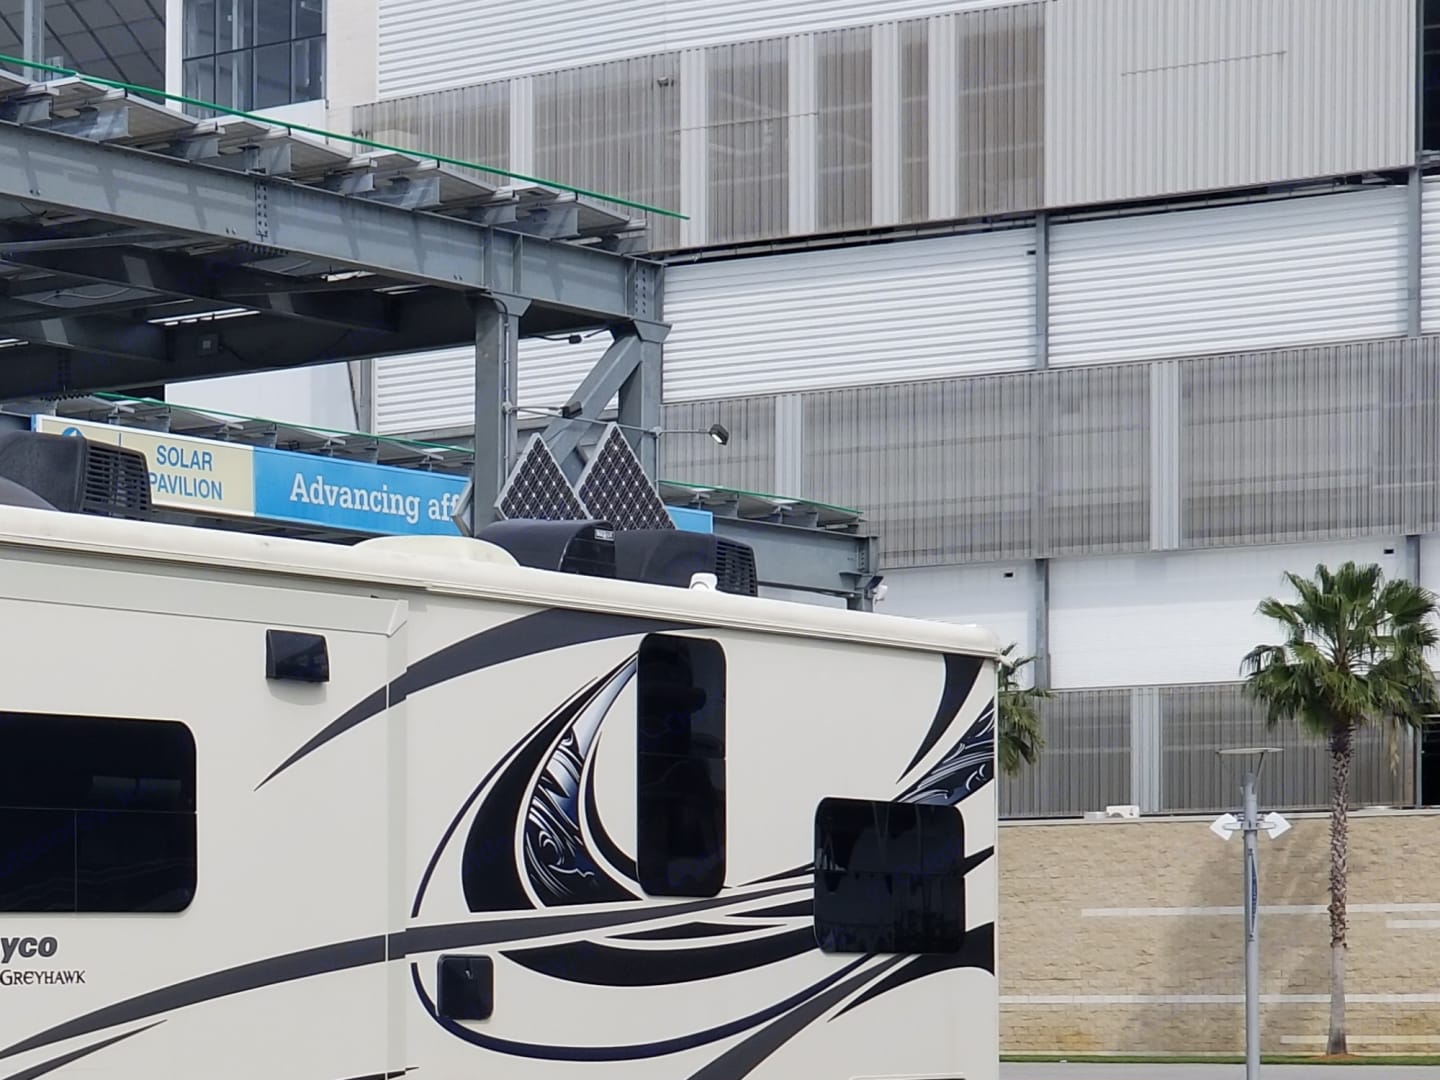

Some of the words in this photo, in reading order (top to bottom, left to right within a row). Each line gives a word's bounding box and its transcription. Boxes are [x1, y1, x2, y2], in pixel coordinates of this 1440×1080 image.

[156, 444, 213, 472] SOLAR
[148, 471, 223, 501] PAVILION
[289, 472, 420, 525] Advancing
[0, 969, 86, 986] GREYHAWK
